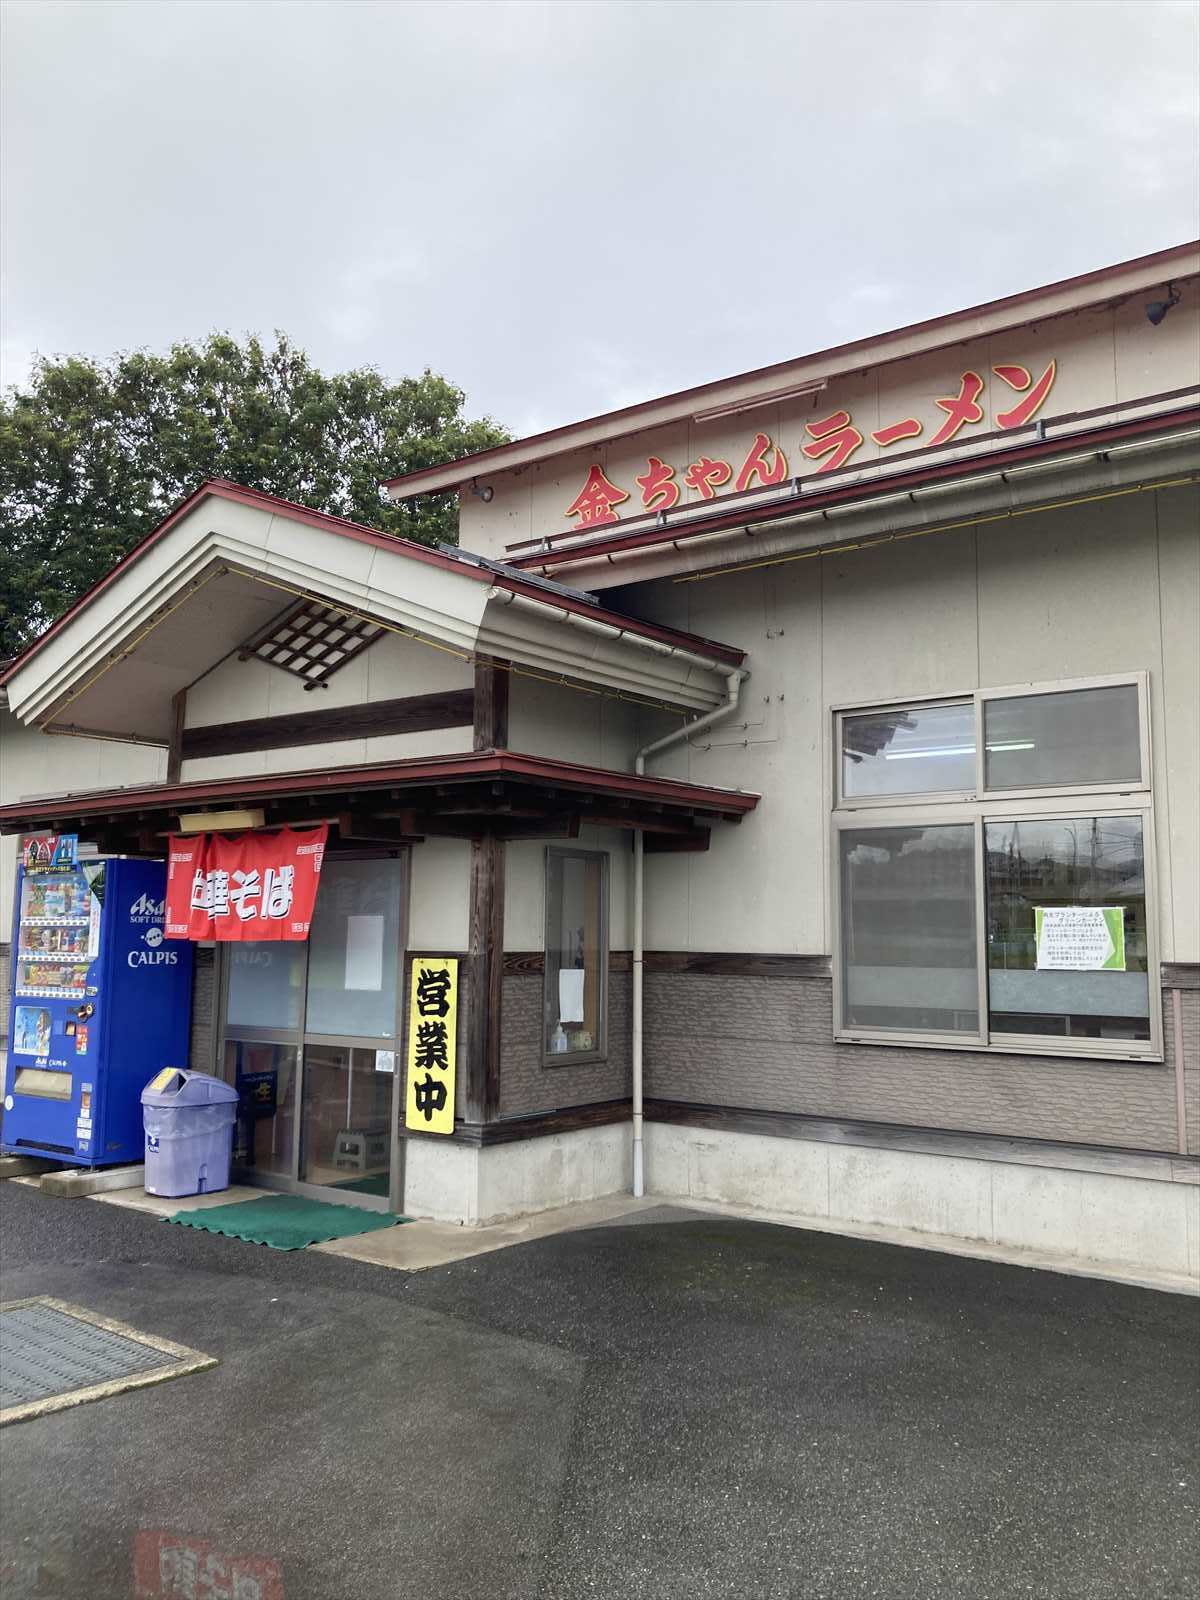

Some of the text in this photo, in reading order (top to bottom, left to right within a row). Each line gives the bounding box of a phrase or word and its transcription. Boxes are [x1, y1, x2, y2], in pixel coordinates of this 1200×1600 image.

[565, 358, 1056, 531] 金ちゃんラーメン
[130, 893, 165, 916] Asa
[130, 916, 151, 924] SOFT
[127, 950, 178, 968] CALPIS
[414, 968, 451, 1122] 営業中
